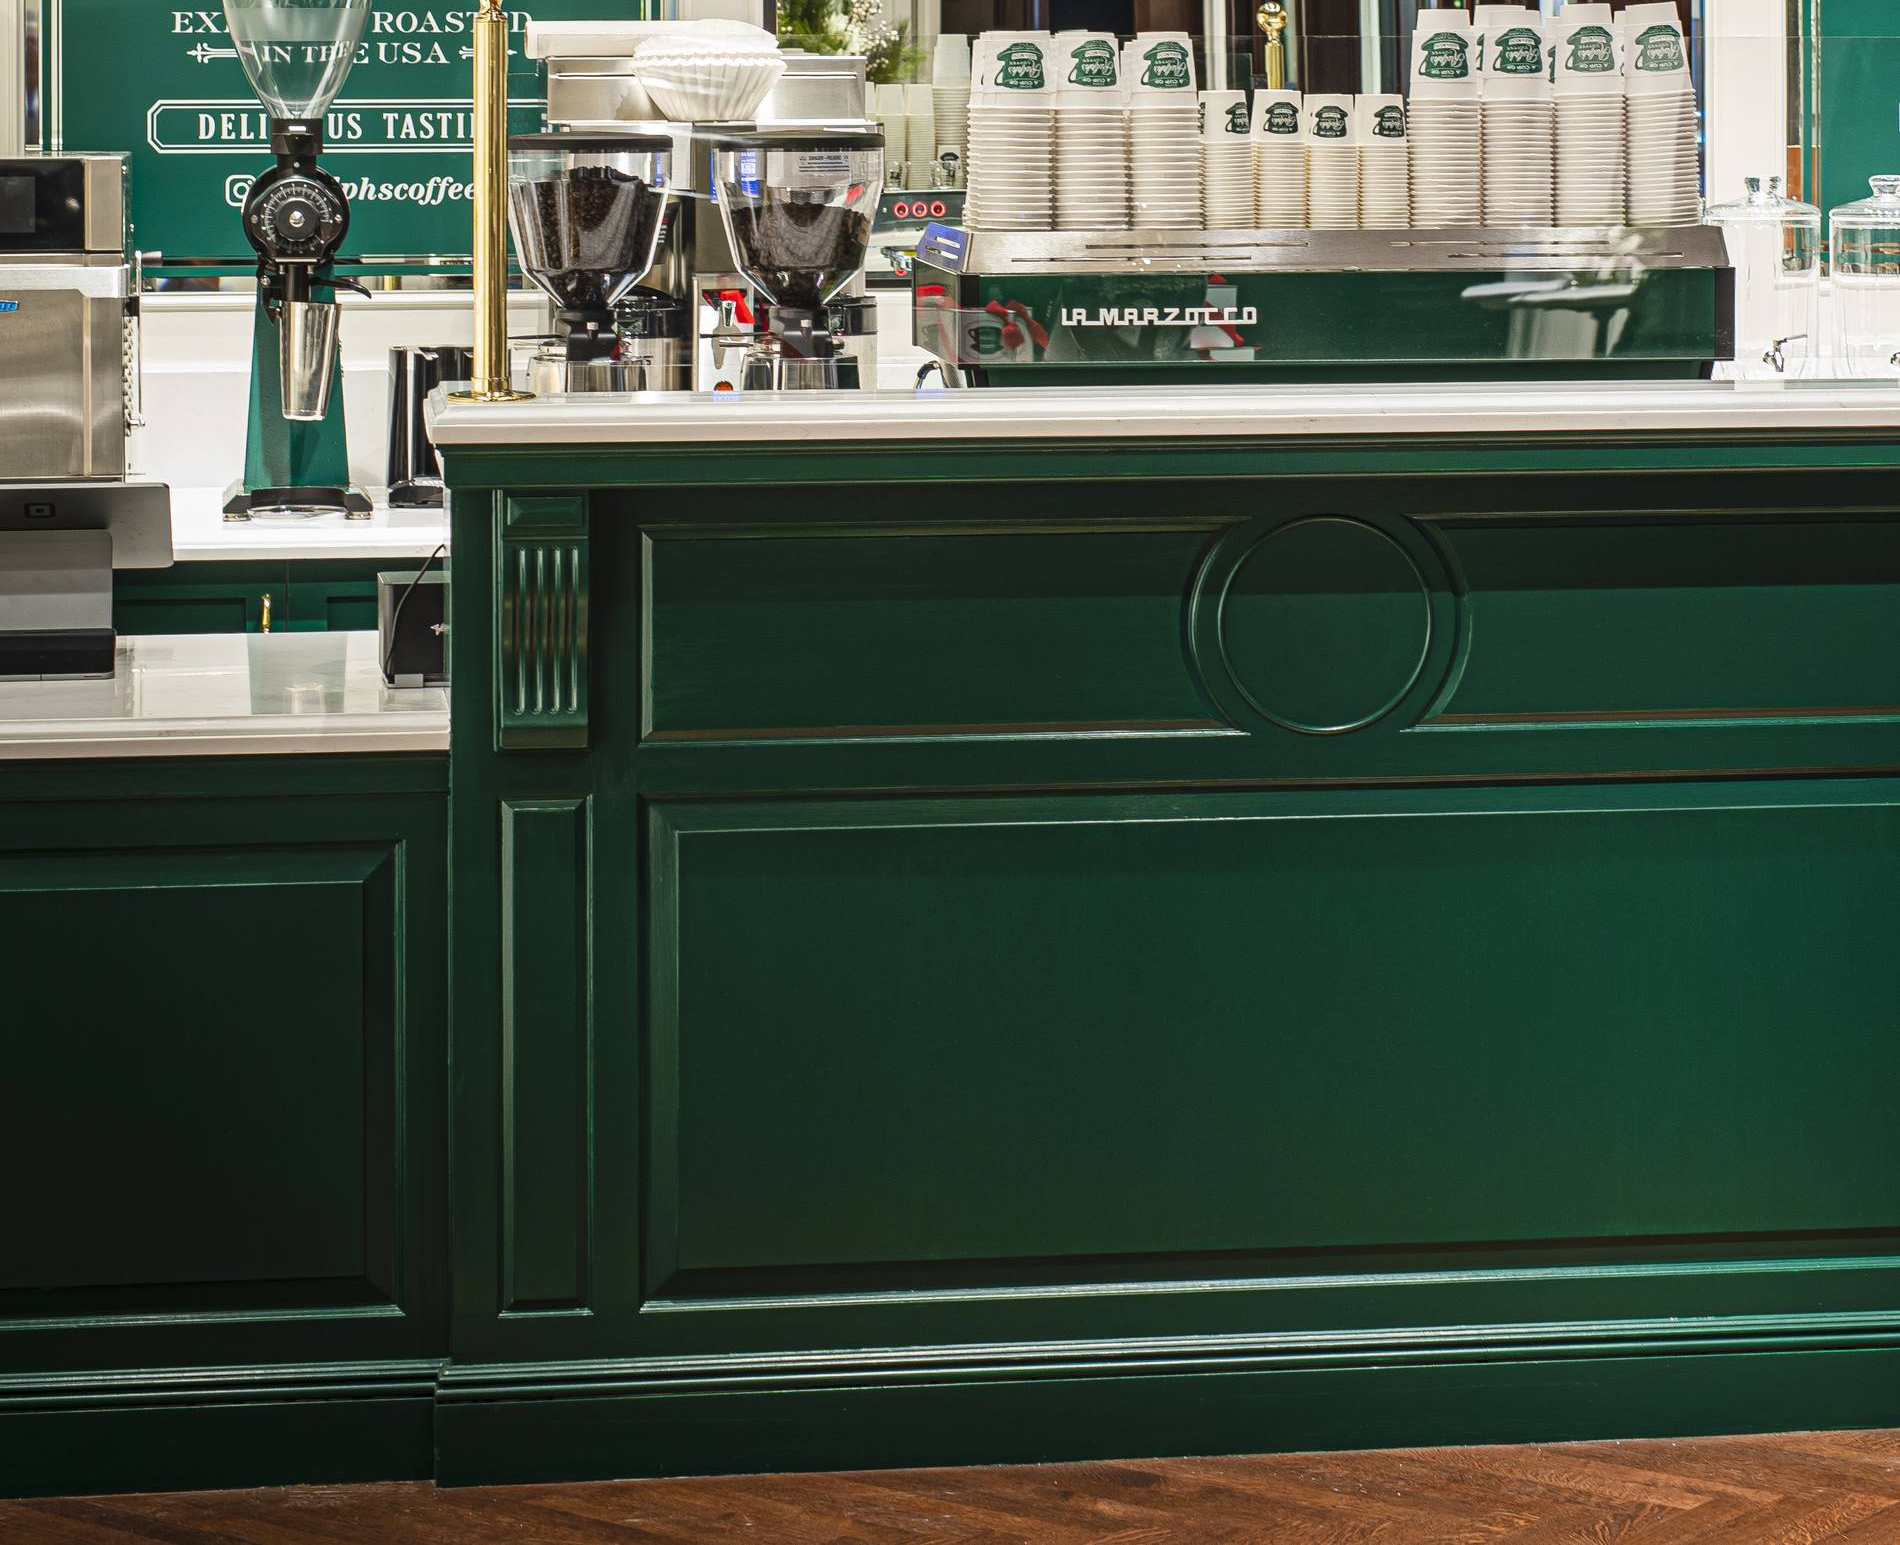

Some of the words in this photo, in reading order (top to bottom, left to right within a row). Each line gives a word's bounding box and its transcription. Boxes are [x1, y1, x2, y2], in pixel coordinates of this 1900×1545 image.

[371, 10, 533, 34] ROASD
[262, 45, 293, 64] IN
[376, 41, 451, 65] USA
[197, 112, 364, 140] DELIUS
[382, 112, 474, 140] TASTI
[1061, 307, 1088, 326] LA
[1098, 306, 1257, 326] MARZOCCO
